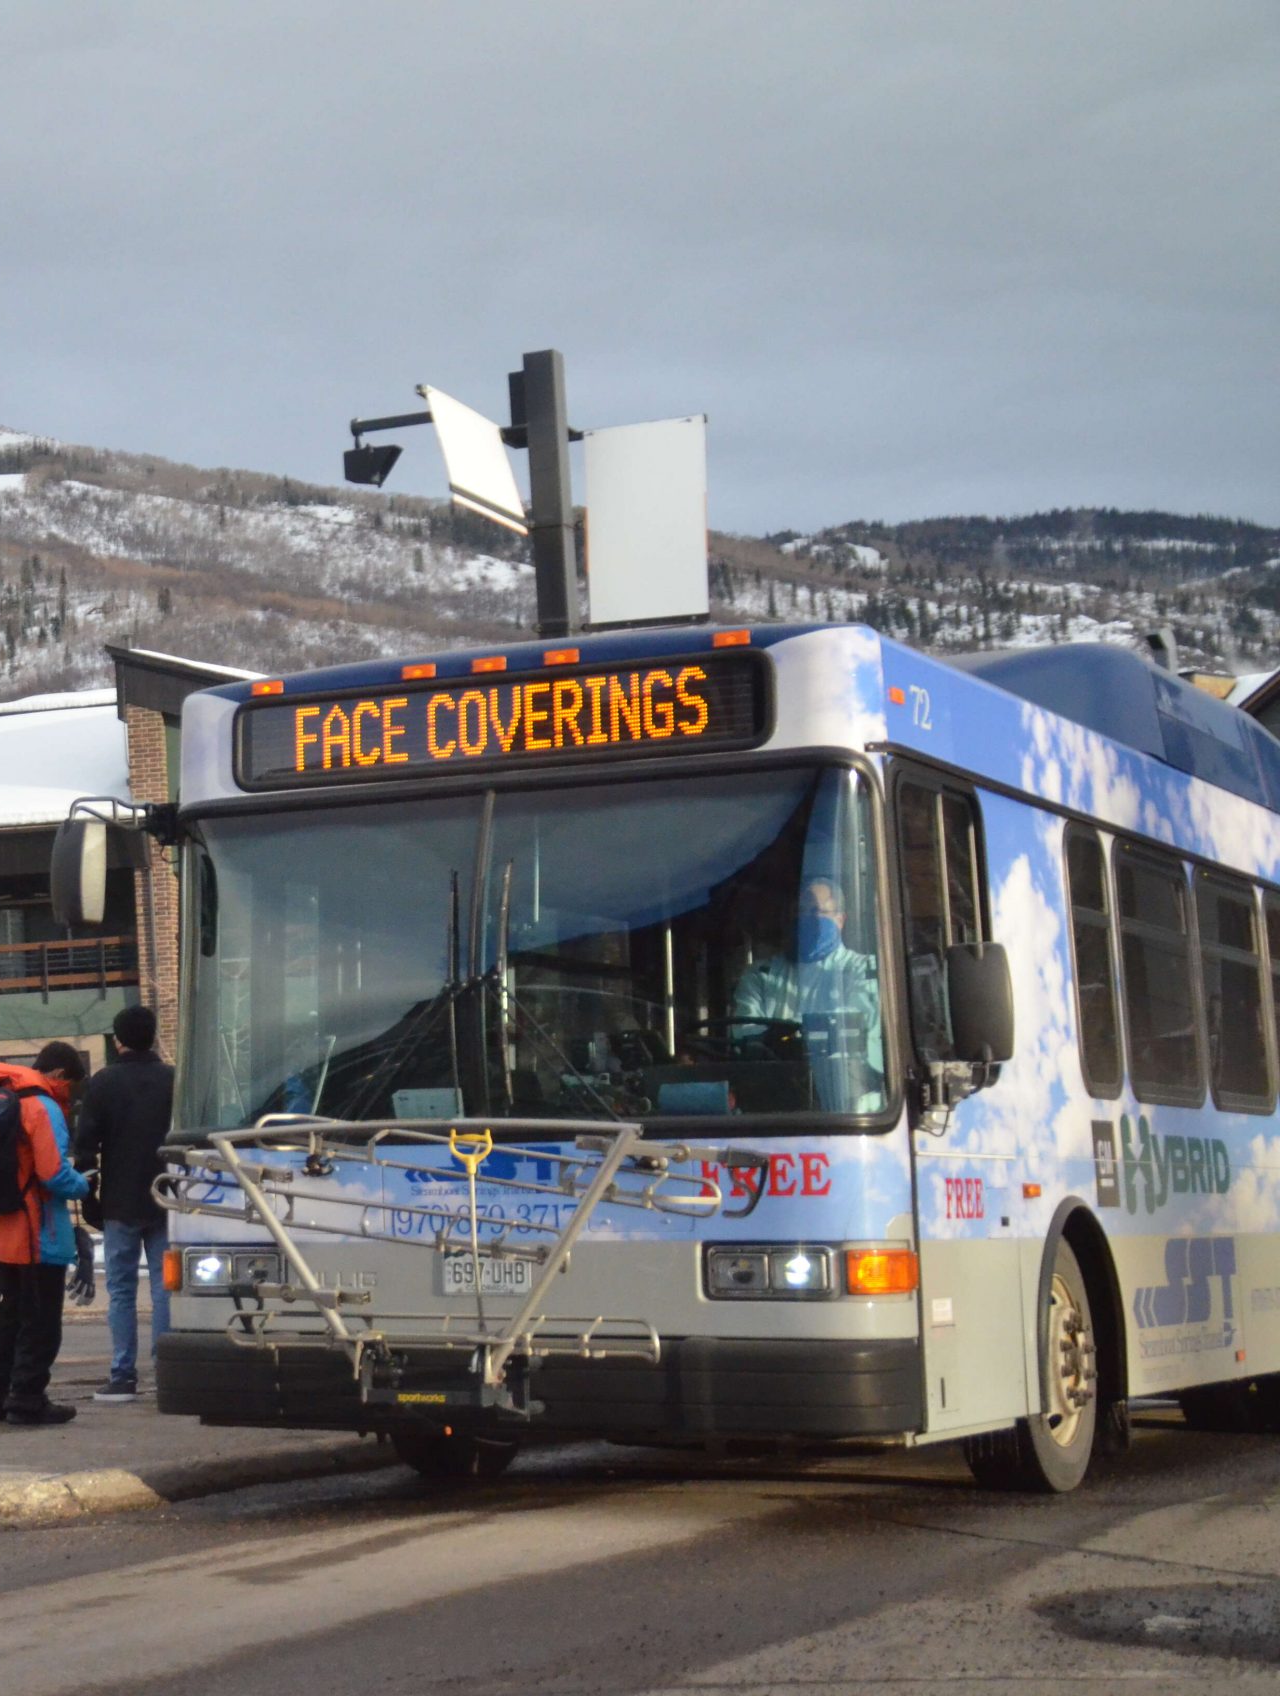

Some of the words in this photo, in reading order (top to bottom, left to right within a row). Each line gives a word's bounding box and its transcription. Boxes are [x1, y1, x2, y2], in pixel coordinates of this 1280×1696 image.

[294, 698, 409, 772] FACE
[426, 665, 709, 759] COVERINGS
[909, 684, 932, 730] 72
[700, 1152, 832, 1197] FREE
[456, 1203, 578, 1235] 8793717
[945, 1177, 985, 1219] FREE
